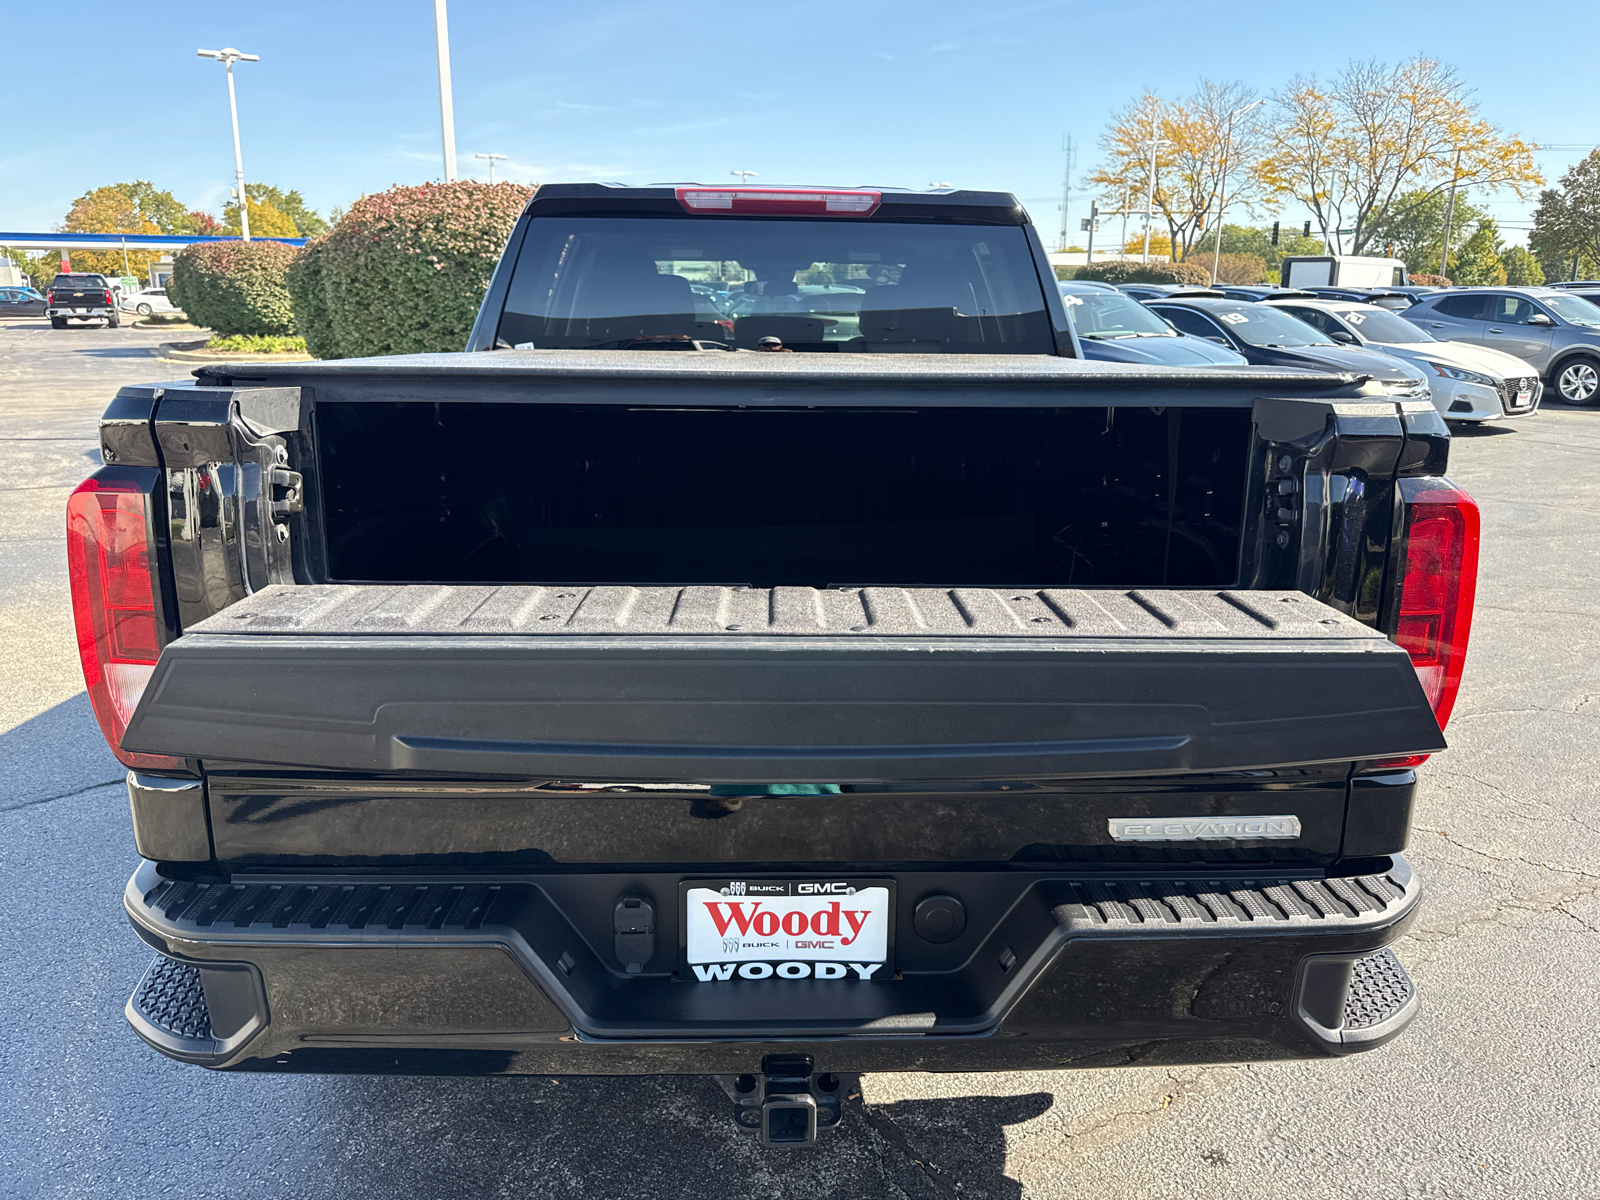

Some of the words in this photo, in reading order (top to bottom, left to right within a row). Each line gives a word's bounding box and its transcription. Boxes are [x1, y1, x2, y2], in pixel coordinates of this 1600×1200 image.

[1220, 312, 1250, 325] 19
[1344, 311, 1367, 325] 21
[1124, 822, 1287, 838] ELEVATION
[798, 882, 848, 894] GMC
[702, 901, 872, 946] Woody
[795, 940, 835, 949] GMC
[691, 962, 883, 982] WOODY
